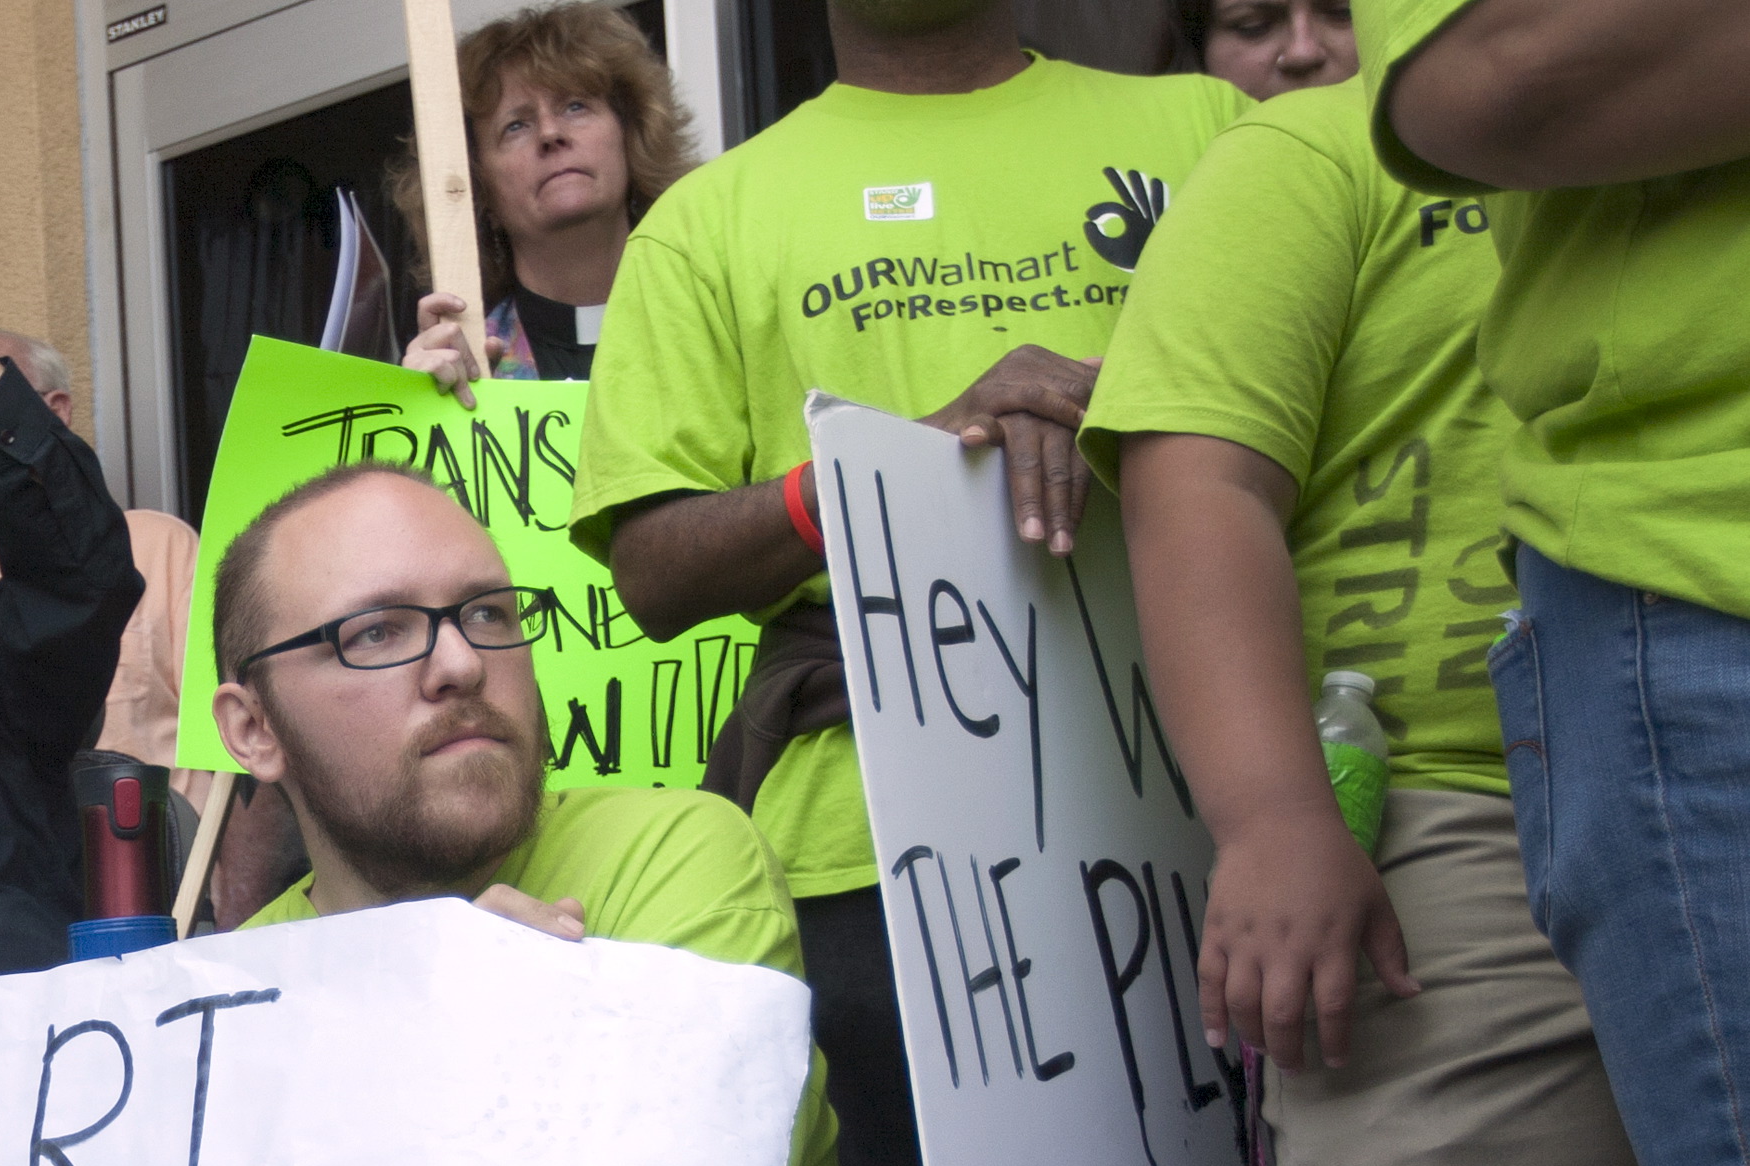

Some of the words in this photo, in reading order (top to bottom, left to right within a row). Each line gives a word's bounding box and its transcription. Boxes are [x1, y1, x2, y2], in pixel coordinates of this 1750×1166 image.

[108, 8, 165, 41] STANLEY
[1418, 199, 1490, 248] Fo
[802, 241, 1078, 318] OURWalmart
[834, 457, 1047, 854] Hey
[891, 845, 1076, 1090] THE
